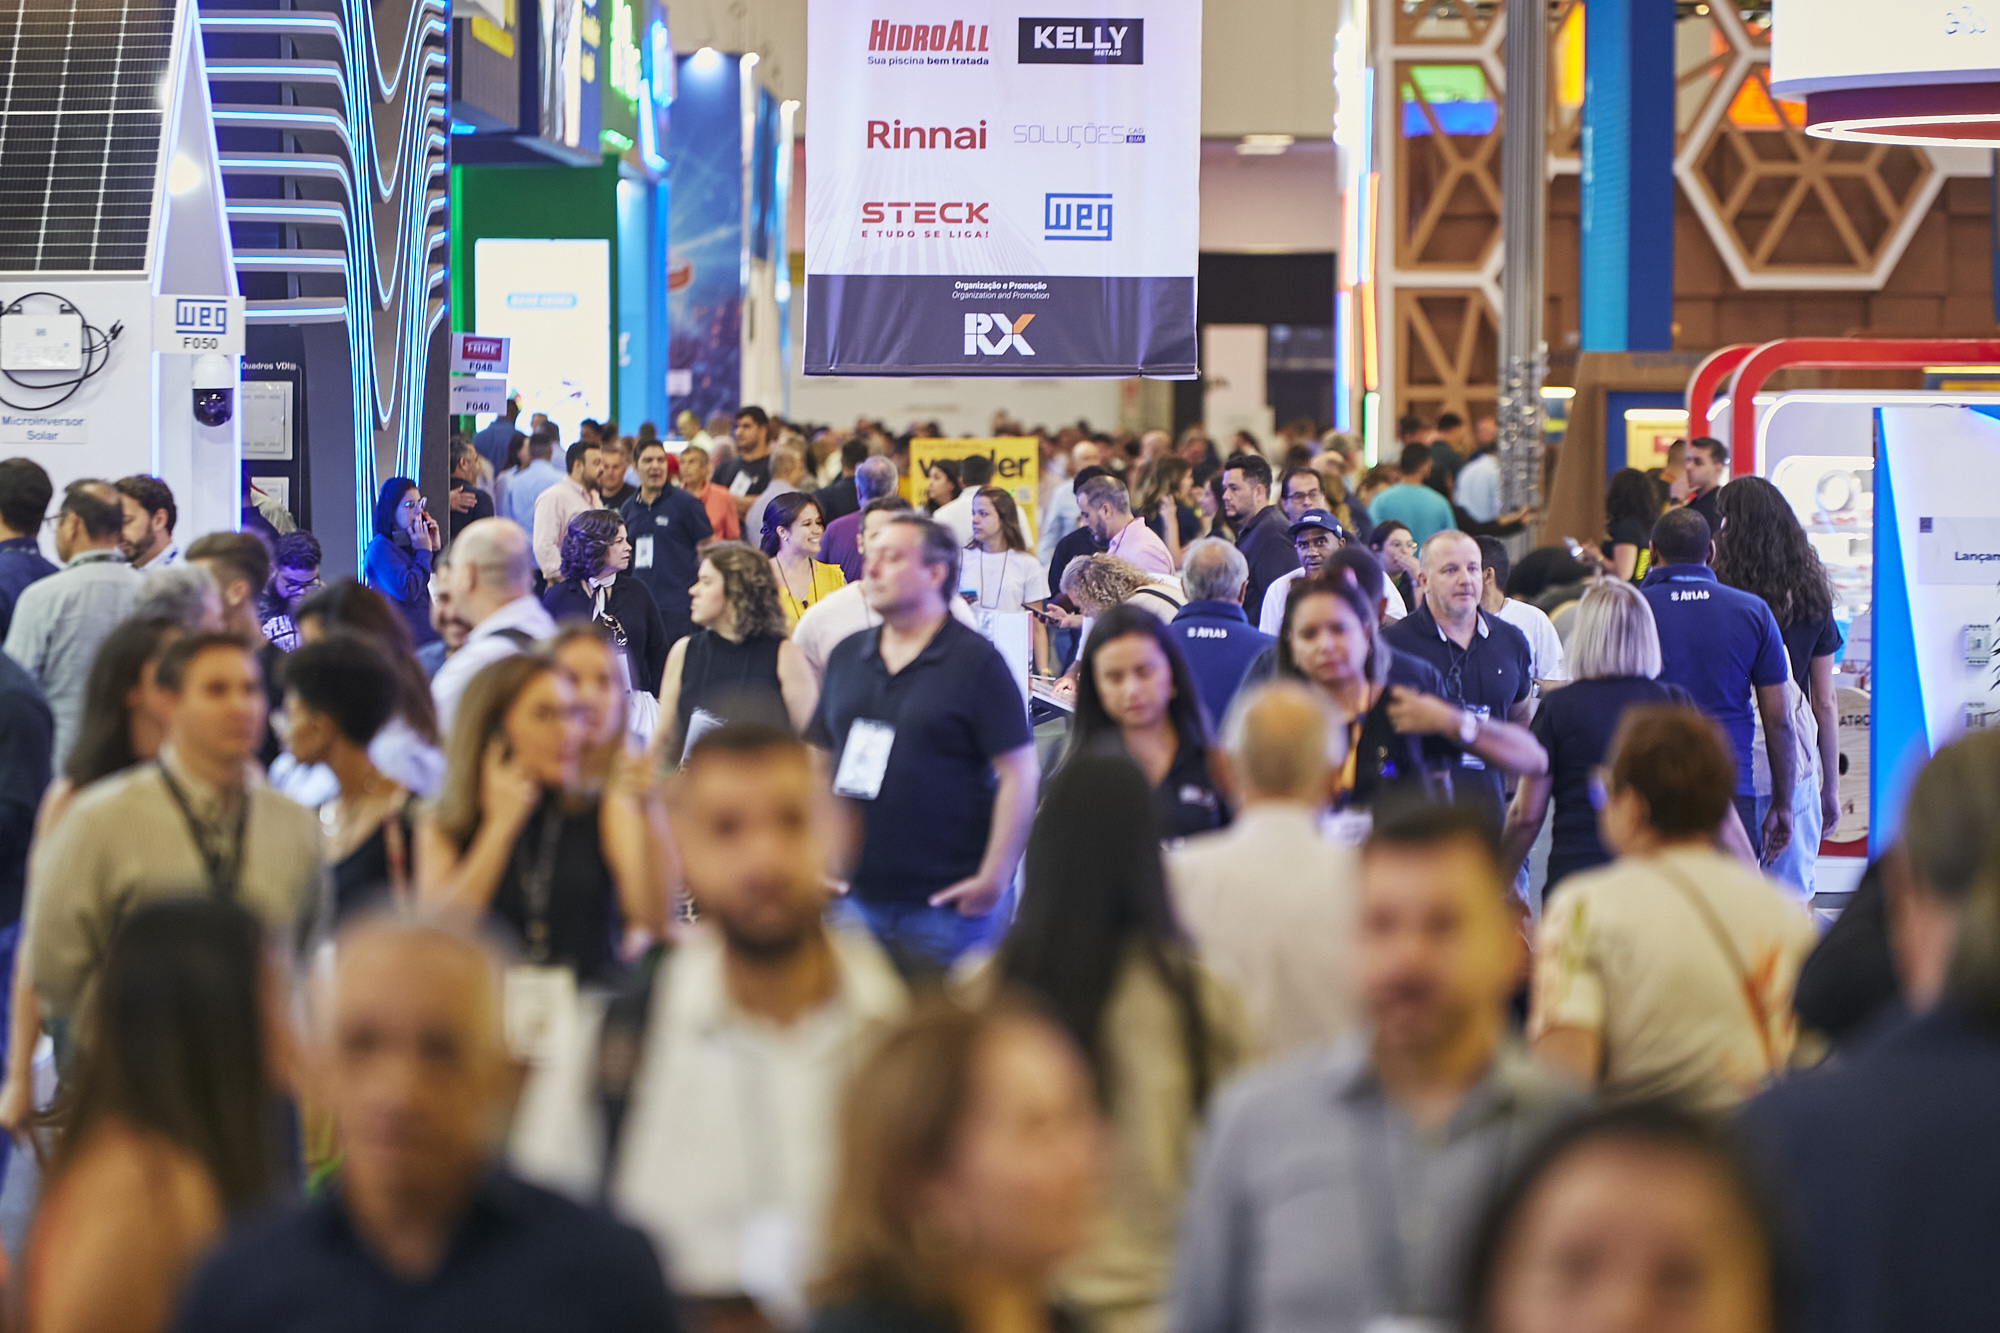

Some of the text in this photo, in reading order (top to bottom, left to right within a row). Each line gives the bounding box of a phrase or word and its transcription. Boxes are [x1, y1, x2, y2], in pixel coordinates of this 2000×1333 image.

[1034, 25, 1128, 49] KELLY
[867, 56, 989, 66] Sua piscina bem tratada
[867, 119, 986, 150] Rinnai
[1013, 122, 1125, 149] SOLUÇÕES
[862, 202, 989, 223] STECK
[949, 230, 989, 238] LIGA!
[955, 281, 1002, 291] Organização
[1009, 281, 1047, 291] Promoção
[952, 290, 1050, 300] Organization and Promotion
[964, 312, 1036, 356] RX
[183, 337, 218, 349] F050
[241, 361, 274, 371] Quadros
[2, 416, 84, 426] Microinversor
[27, 430, 59, 441] Solar
[919, 449, 1030, 478] ver
[1680, 590, 1710, 601] ATLAS
